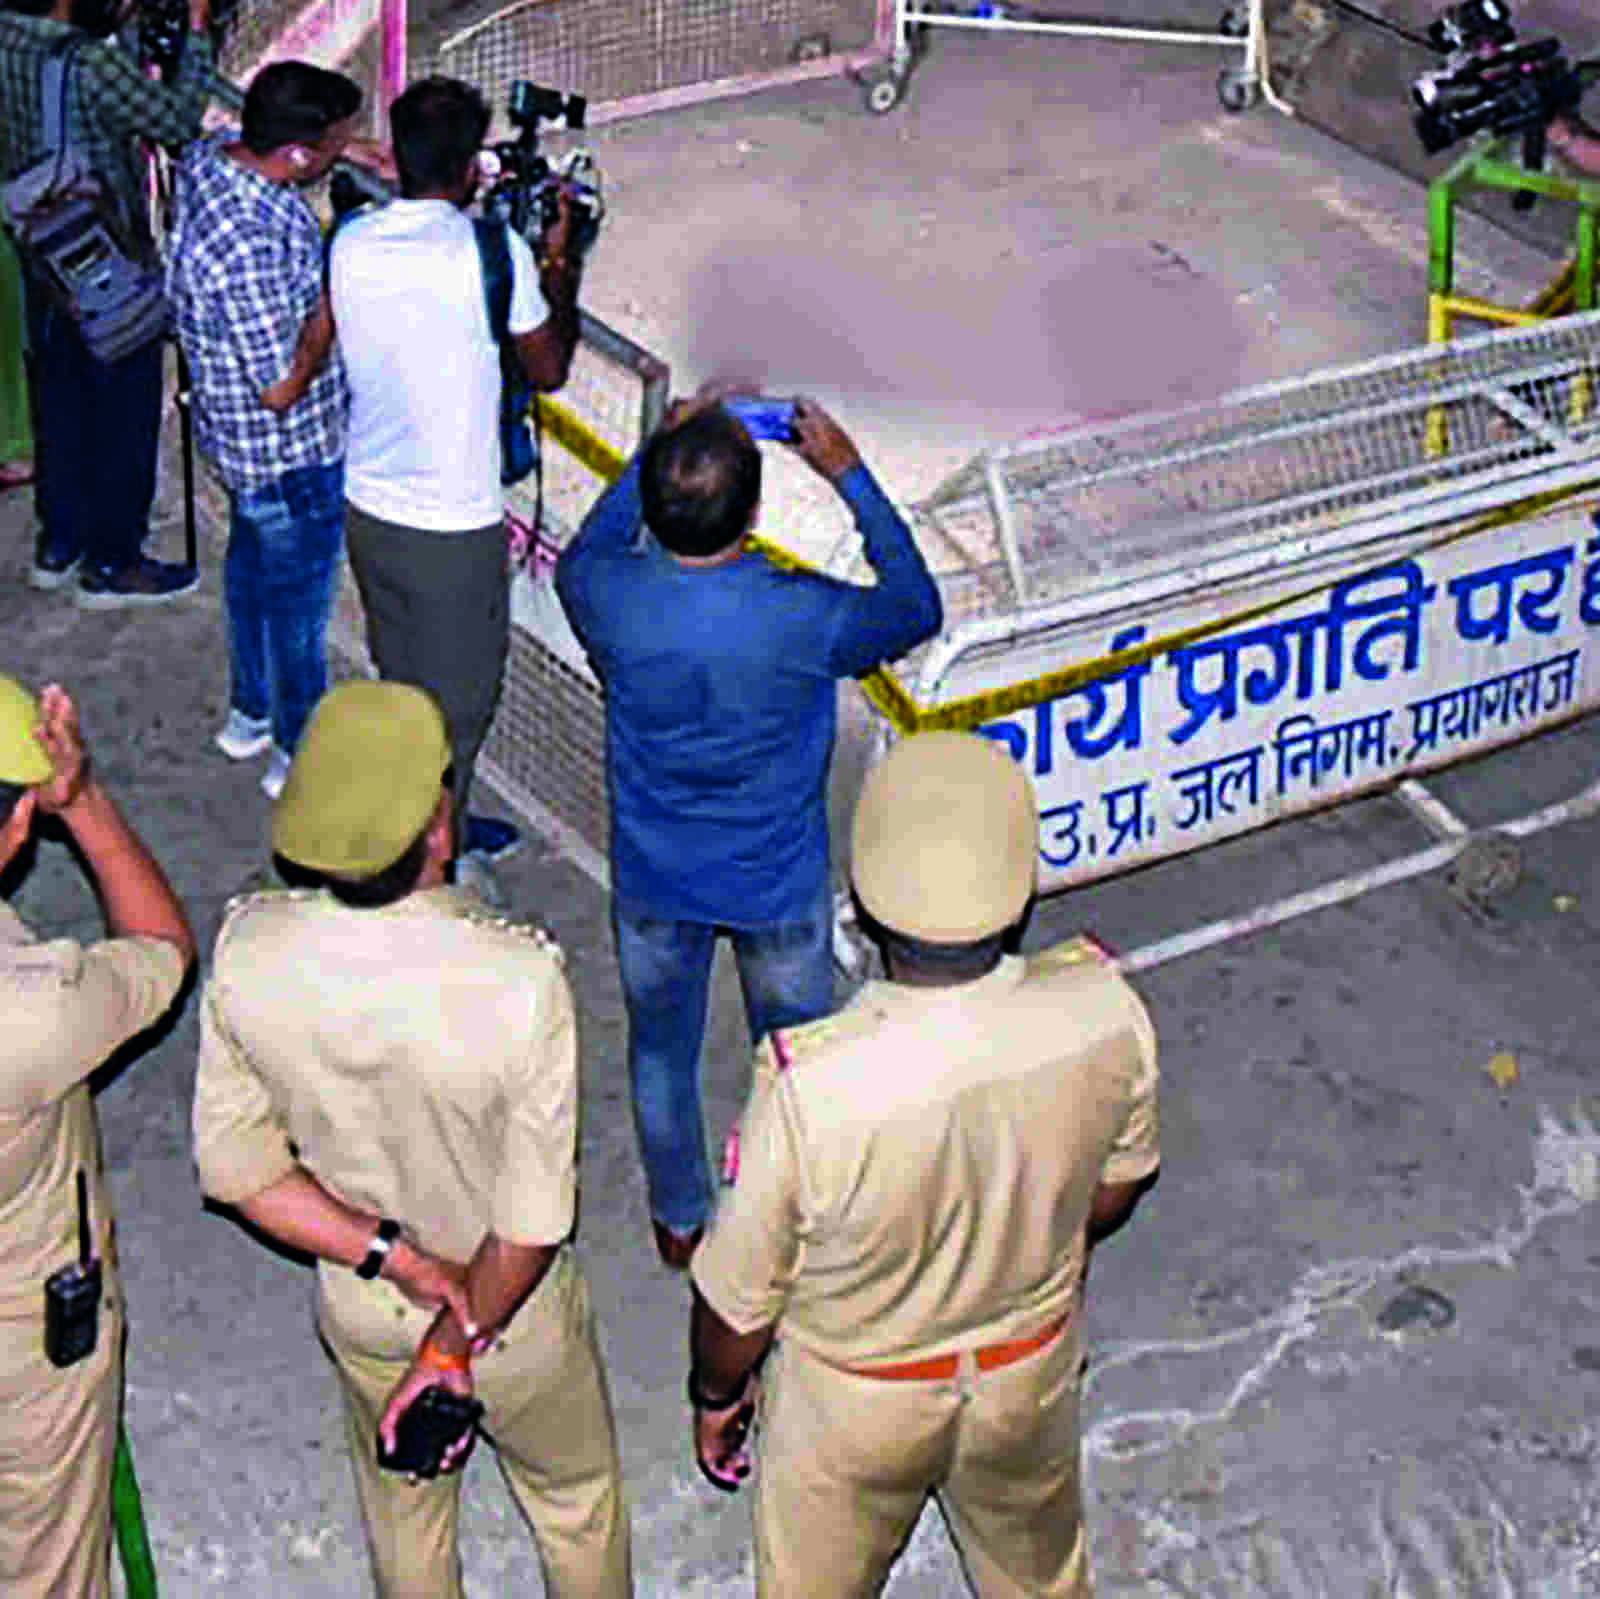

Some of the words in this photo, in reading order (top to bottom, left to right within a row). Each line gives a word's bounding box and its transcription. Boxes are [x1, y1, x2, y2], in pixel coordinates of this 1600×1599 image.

[1167, 558, 1437, 745] प्रगति
[1447, 544, 1576, 647] पर
[1169, 744, 1265, 831] जल
[1405, 648, 1582, 762] प्रयागराज
